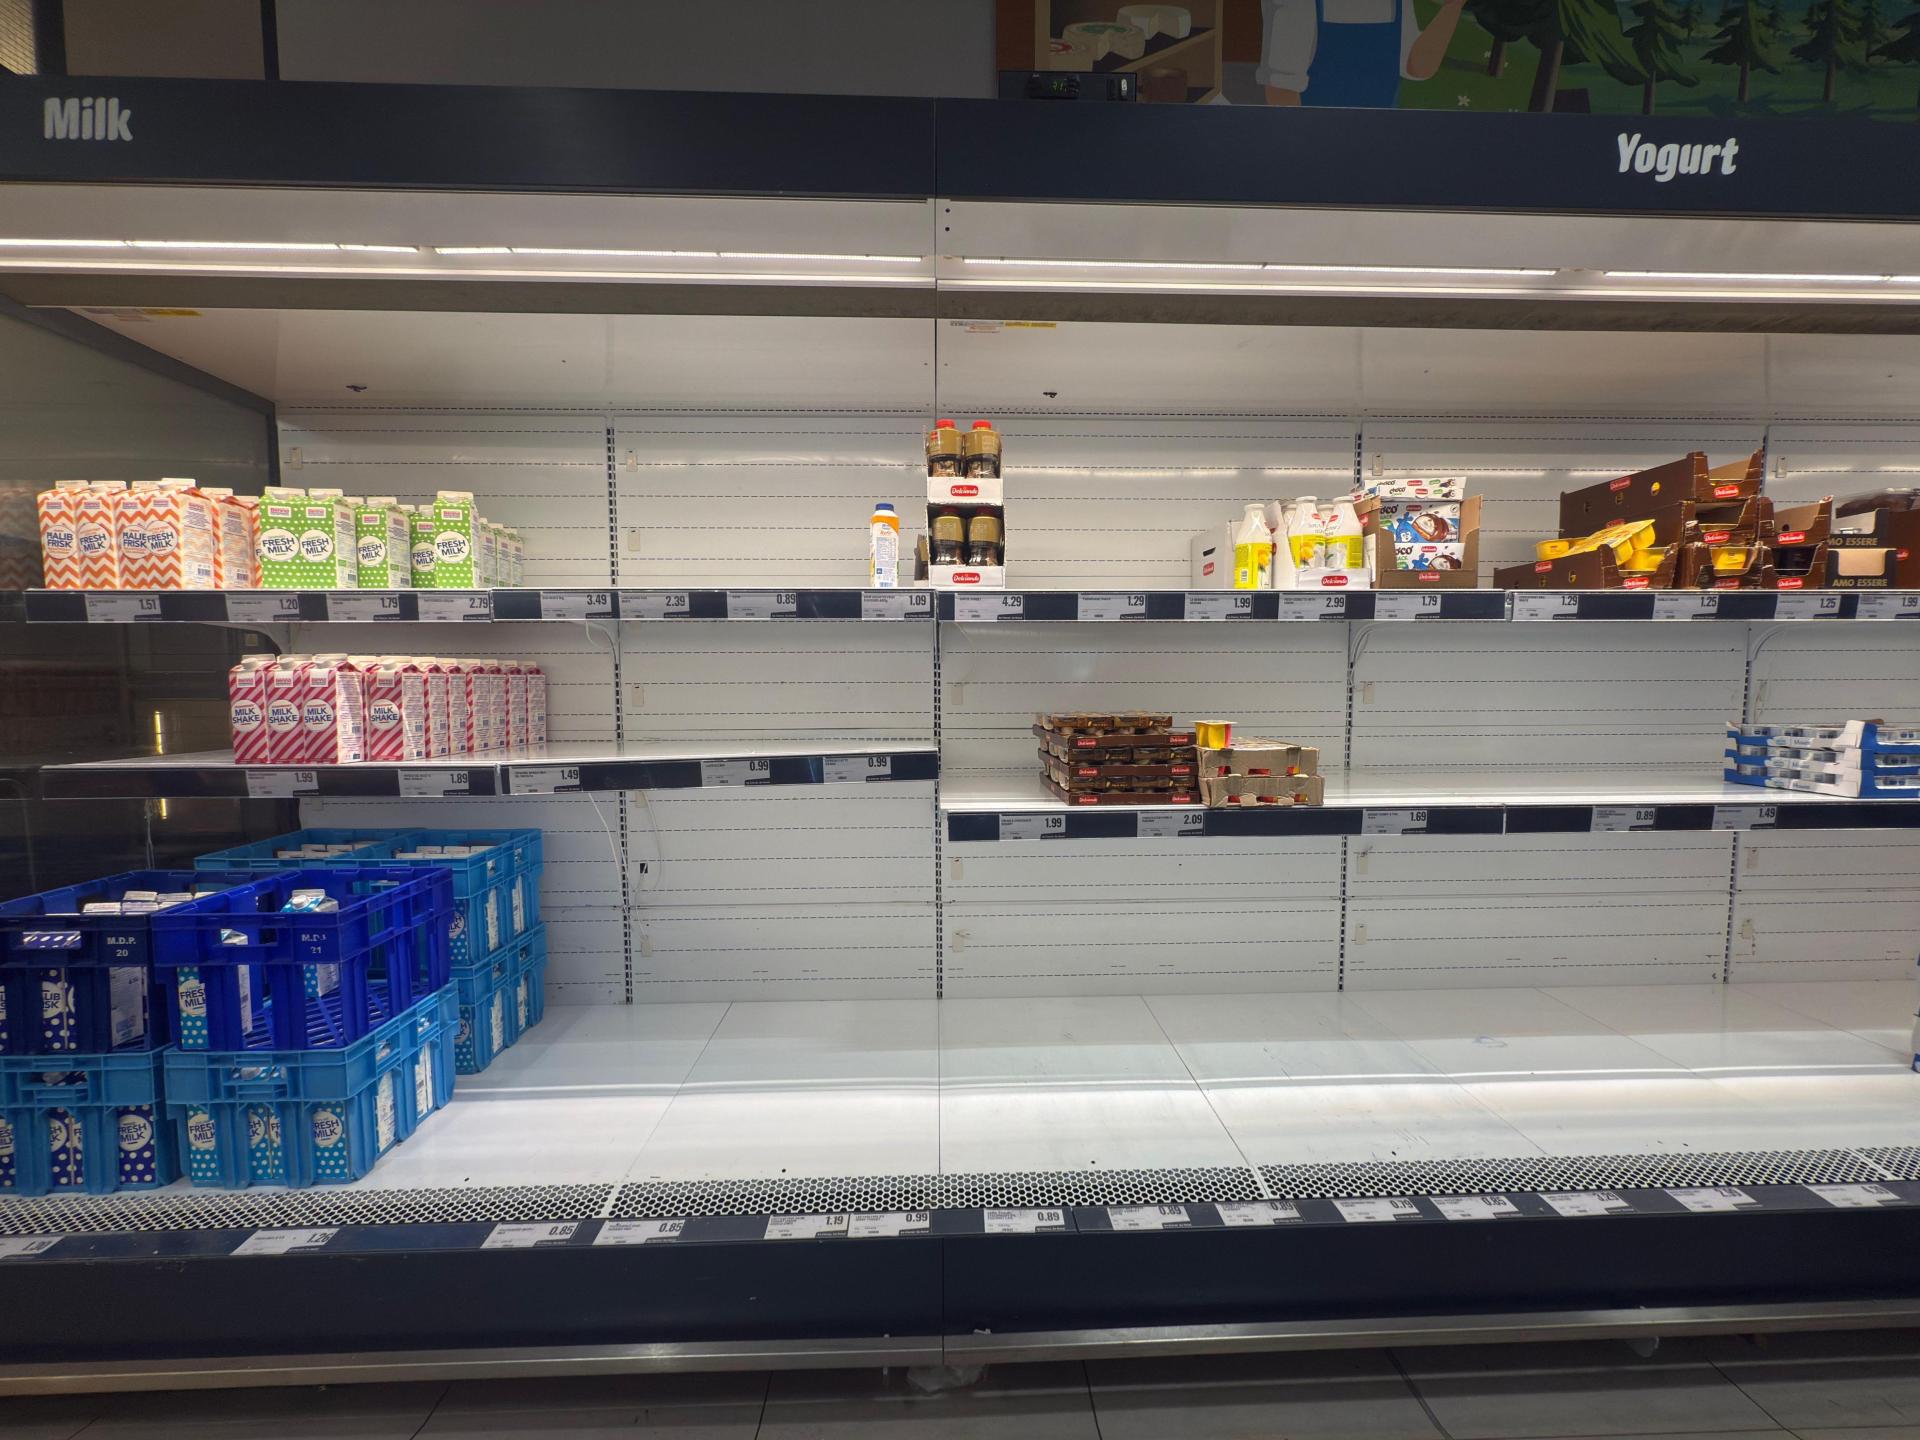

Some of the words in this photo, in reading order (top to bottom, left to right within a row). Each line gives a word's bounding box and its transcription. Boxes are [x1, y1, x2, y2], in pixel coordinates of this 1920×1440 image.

[44, 97, 133, 141] Milk
[1618, 133, 1739, 182] Yogurt
[80, 533, 107, 544] FRESH
[147, 531, 174, 543] FRESH
[262, 537, 296, 547] FRESH
[1845, 538, 1879, 546] ESSERE
[47, 539, 73, 549] FRISK
[83, 541, 106, 552] MILK
[150, 539, 173, 550] MILK
[302, 537, 330, 549] FRESH
[358, 543, 383, 554] FRESH
[437, 539, 467, 550] FRESH
[267, 544, 294, 555] MILK
[306, 545, 329, 555] MILK
[361, 550, 382, 560] MILK
[441, 546, 466, 556] MILK
[415, 556, 436, 566] MILK
[1832, 579, 1855, 587] AMO
[1857, 579, 1889, 587] ESSERE
[380, 597, 398, 609] 1.79
[469, 597, 489, 609] 2.79
[586, 594, 608, 606] 3.49
[665, 595, 686, 607] 2.39
[776, 593, 796, 605] 0.89
[909, 595, 927, 606] 1.09
[1002, 596, 1022, 607] 4.29
[1127, 595, 1144, 607] 1.29
[1233, 597, 1251, 609] 1.99
[1326, 597, 1345, 608] 2.99
[1422, 595, 1438, 606] 1.79
[1561, 595, 1578, 606] 1.29
[1700, 596, 1718, 607] 1.25
[1819, 598, 1837, 609] 1.25
[139, 599, 157, 611] 1.51
[280, 599, 298, 611] 1.20
[234, 707, 255, 716] MILK
[271, 707, 293, 716] MILK
[306, 707, 329, 716] MILK
[373, 706, 394, 715] MILK
[232, 714, 261, 724] SHAKE
[268, 714, 298, 724] SHAKE
[304, 714, 332, 724] SHAKE
[370, 713, 399, 722] SHAKE
[749, 760, 769, 772] 0.99
[868, 757, 887, 768] 0.99
[294, 772, 313, 784] 1.99
[450, 773, 468, 785] 1.89
[560, 769, 579, 781] 1.49
[1410, 811, 1426, 822] 1.69
[1635, 810, 1654, 821] 0.89
[1758, 807, 1776, 818] 1.49
[1045, 817, 1062, 828] 1.99
[1183, 813, 1203, 825] 2.09
[107, 936, 137, 945] M.D.P.
[116, 949, 129, 957] 20
[180, 988, 205, 1000] FRES
[1158, 1204, 1182, 1215] 0.89
[1270, 1200, 1294, 1211] 0.89
[1390, 1199, 1414, 1209] 0.79
[826, 1215, 844, 1225] 1.19
[905, 1212, 929, 1223] 0.99
[1037, 1211, 1060, 1222] 0.89
[549, 1225, 575, 1236] 0.85
[659, 1222, 684, 1233] 0.85
